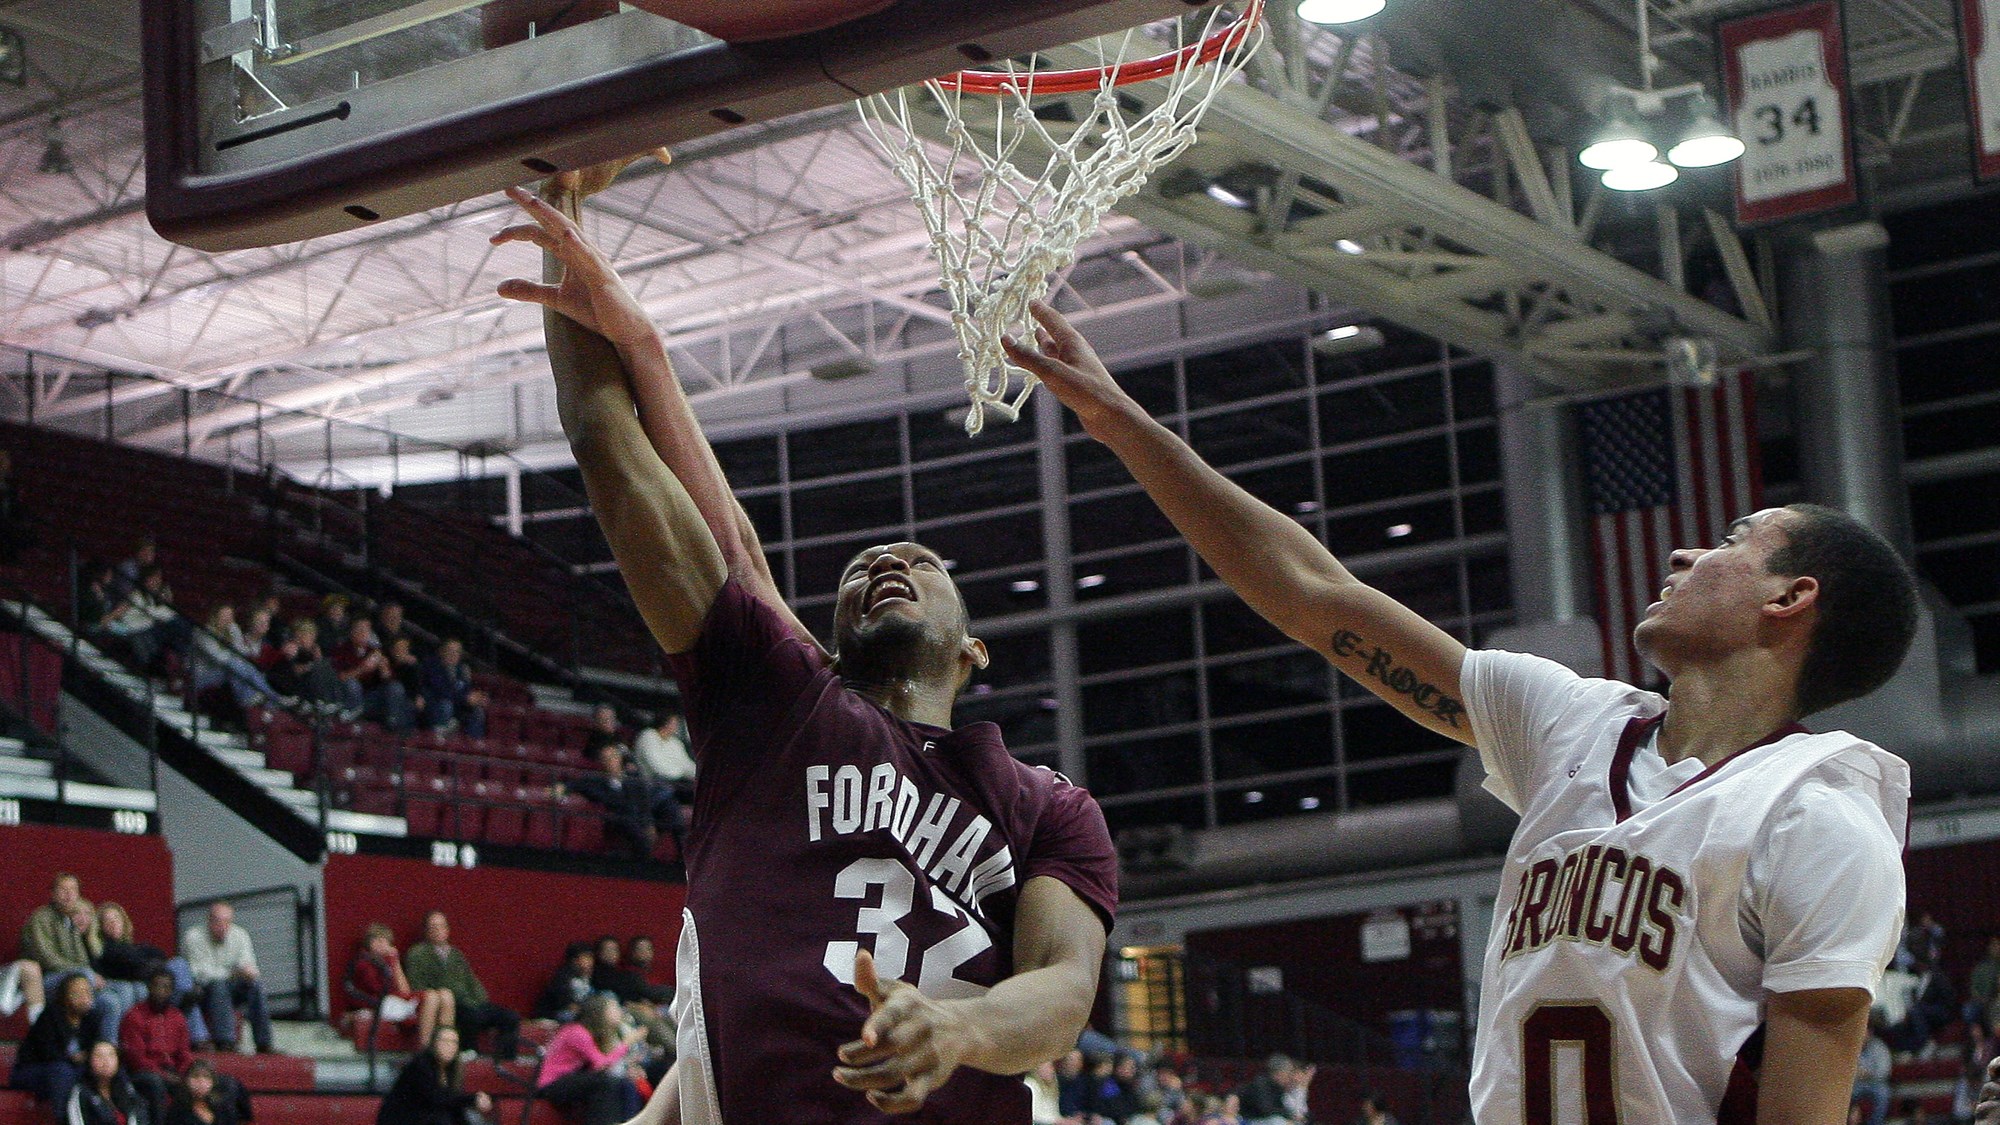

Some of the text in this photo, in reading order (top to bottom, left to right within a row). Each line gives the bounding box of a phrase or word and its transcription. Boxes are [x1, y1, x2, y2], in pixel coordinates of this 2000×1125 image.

[1754, 96, 1820, 145] 34
[1332, 629, 1465, 728] E-ROCK
[806, 762, 1016, 918] FORDHAM
[823, 858, 992, 1000] 32
[1500, 843, 1685, 975] BRONCOS
[1519, 1000, 1622, 1125] 0
